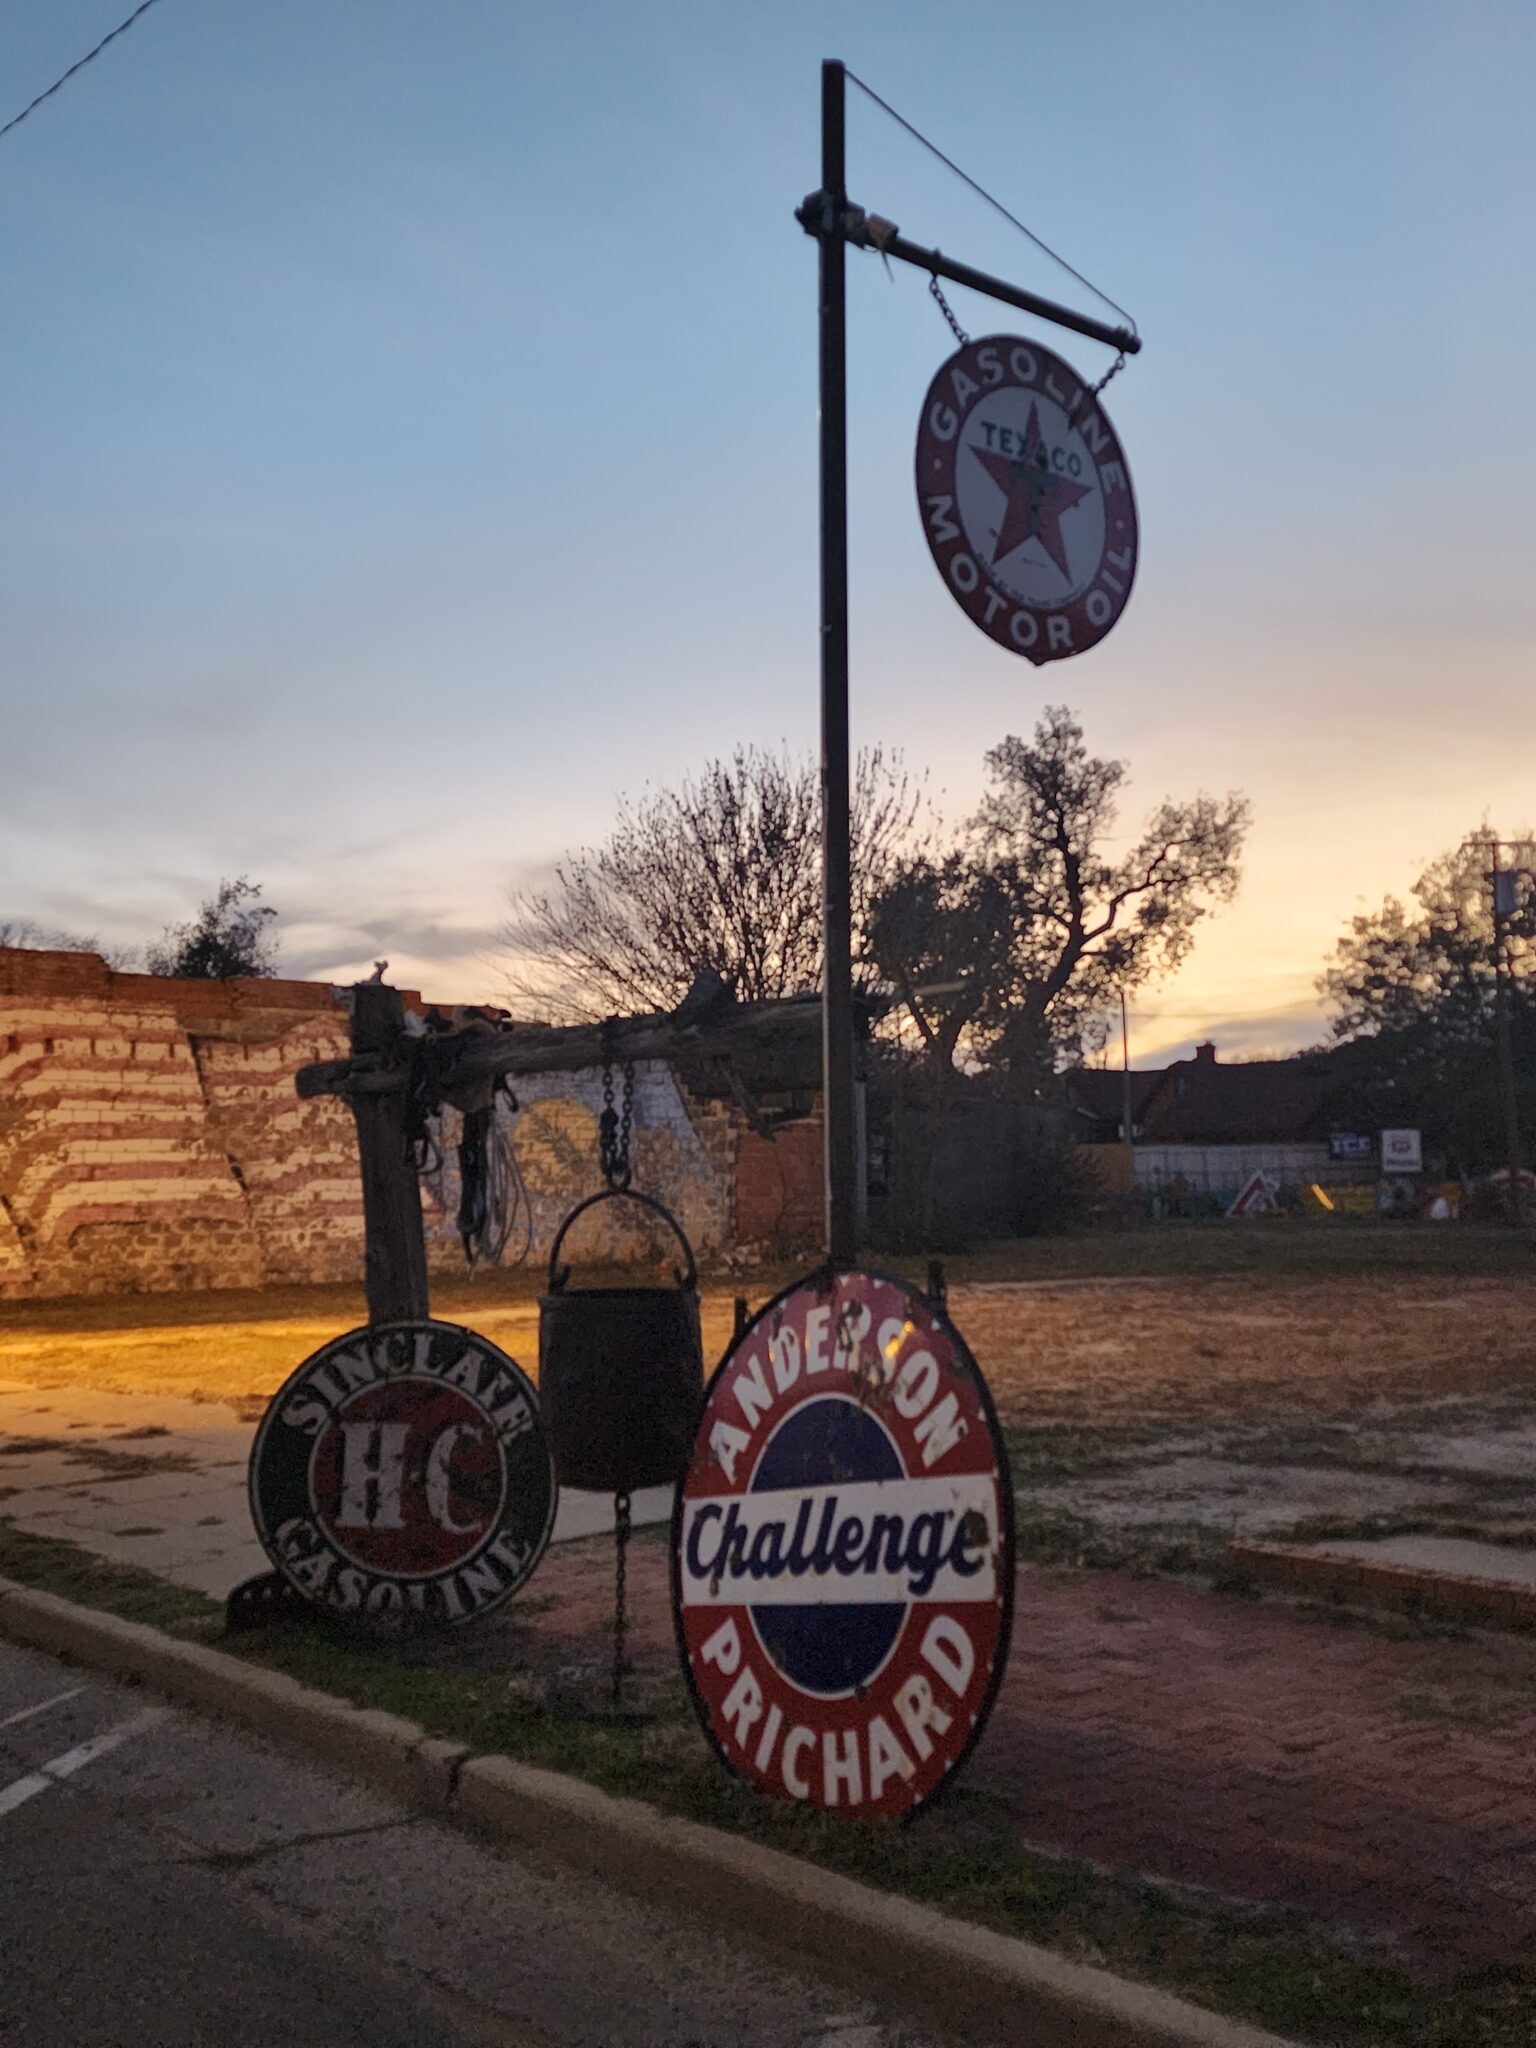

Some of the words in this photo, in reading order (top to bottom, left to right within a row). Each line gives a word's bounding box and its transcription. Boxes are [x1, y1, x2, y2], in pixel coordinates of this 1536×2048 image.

[930, 347, 1126, 494] GASOLINE
[981, 421, 1081, 476] TEXACO
[927, 495, 1074, 649] MOTOR
[1086, 546, 1132, 626] OIL
[282, 1333, 533, 1445] SINCLAIR
[709, 1300, 968, 1484] ANDERSON
[686, 1497, 987, 1596] Challenge
[701, 1614, 975, 1806] PRICHARD
